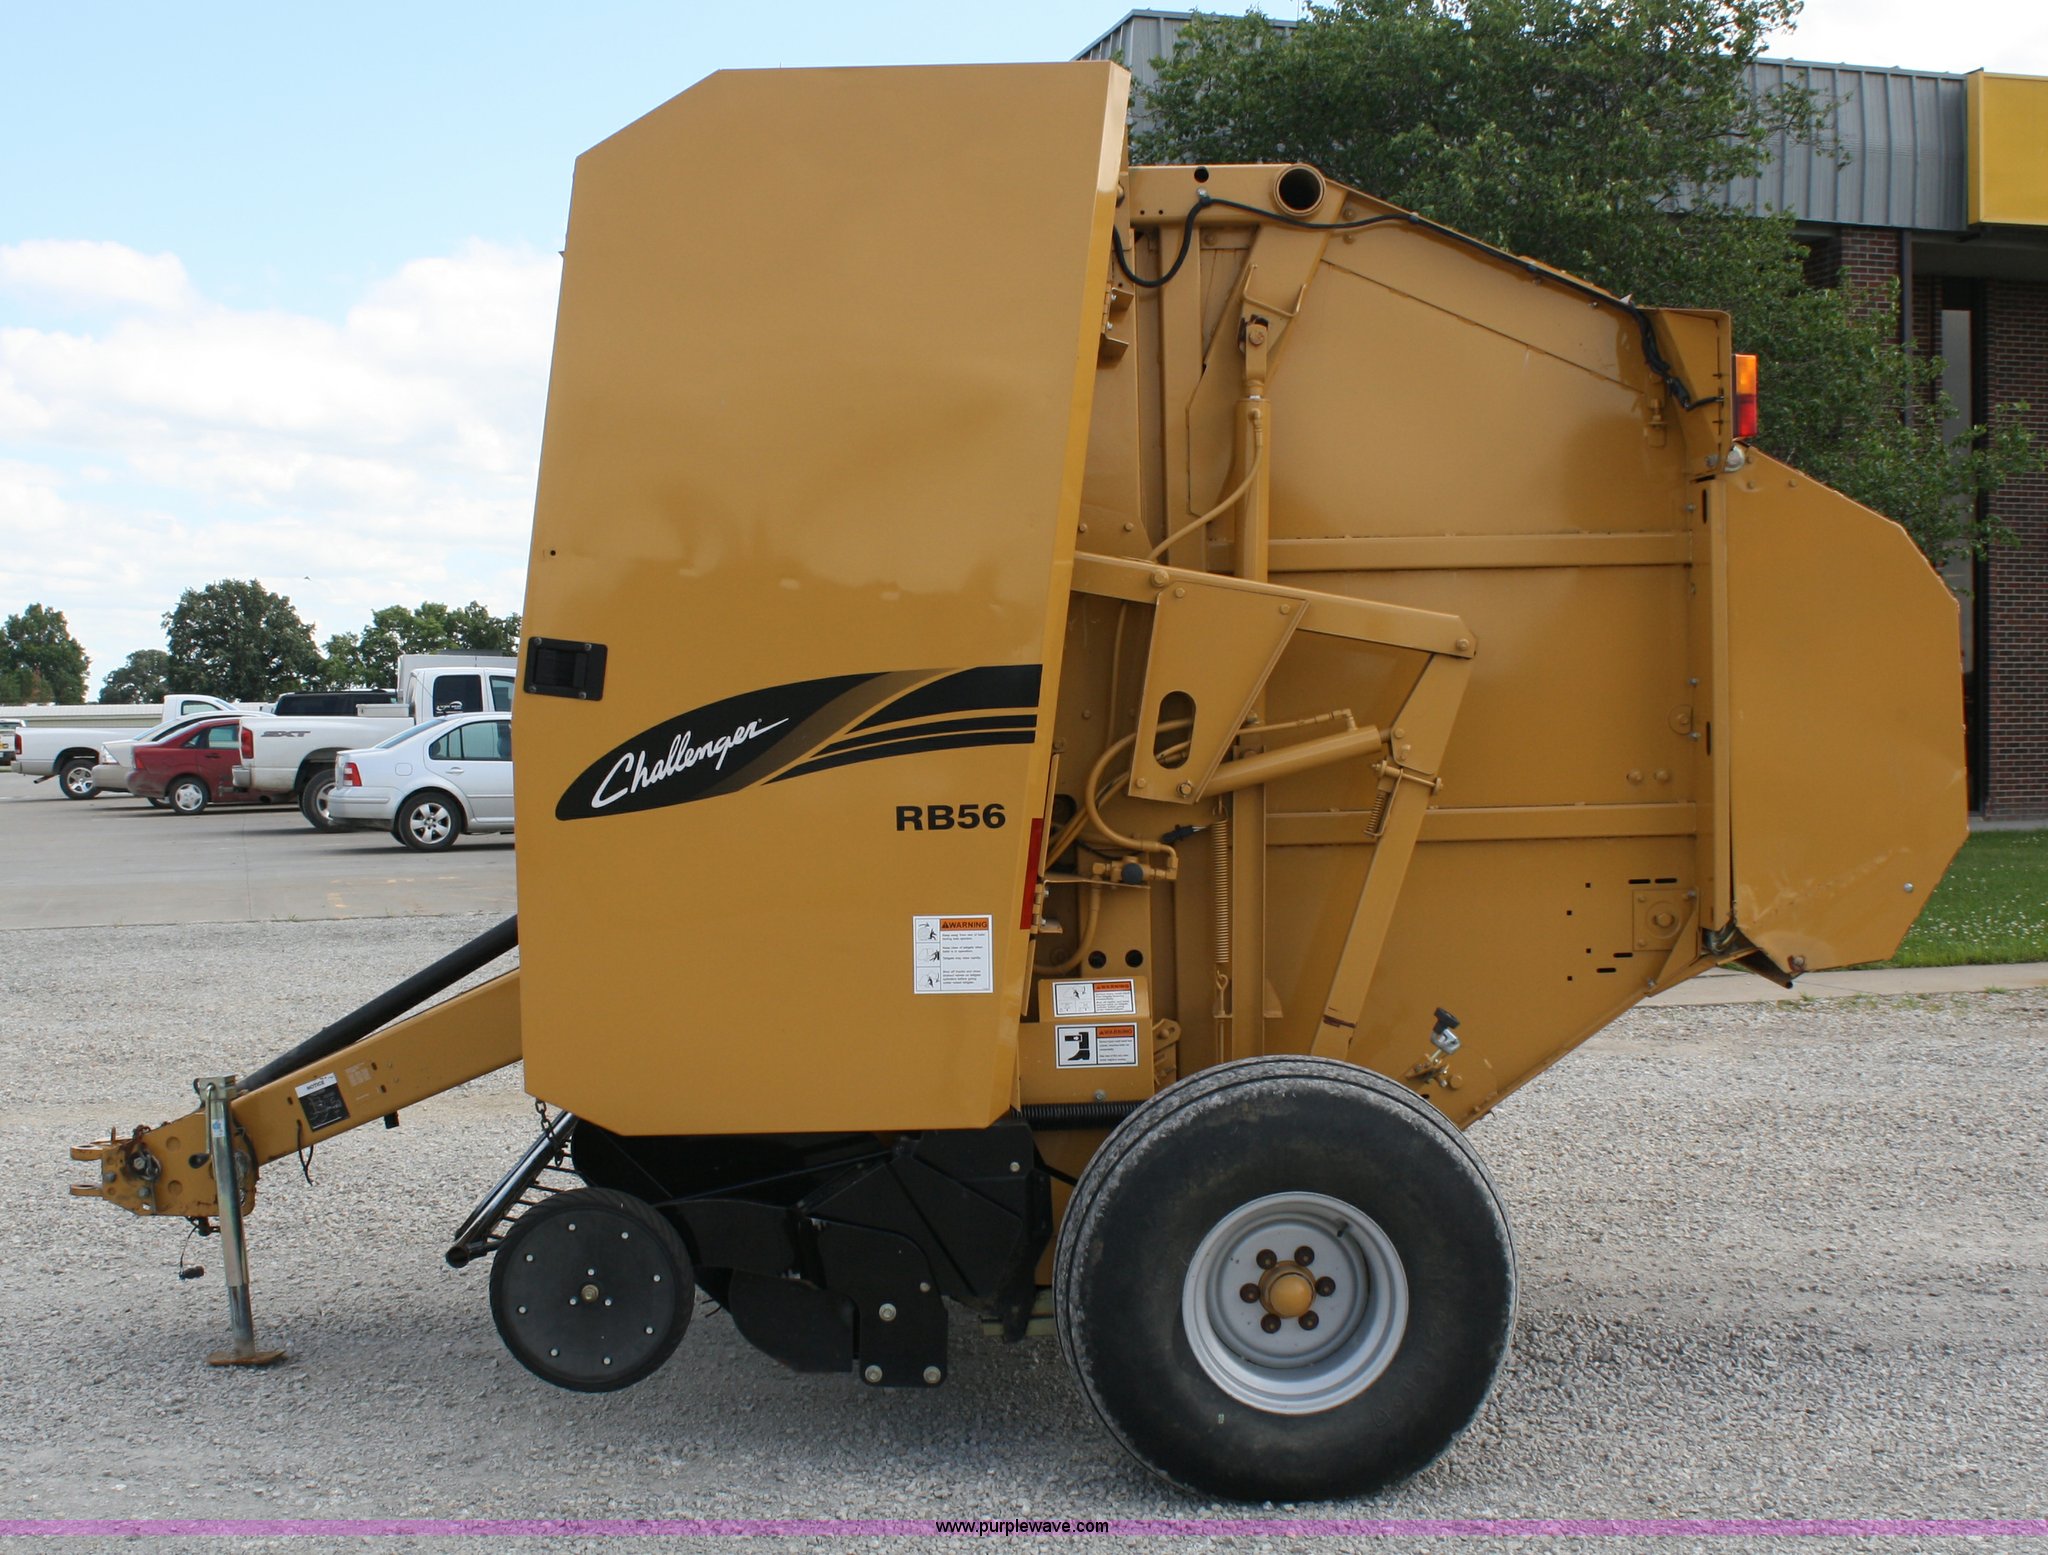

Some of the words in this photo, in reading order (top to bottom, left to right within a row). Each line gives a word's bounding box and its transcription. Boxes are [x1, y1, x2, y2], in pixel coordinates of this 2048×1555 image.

[591, 717, 789, 808] Challenger
[895, 803, 1006, 831] RB56
[949, 921, 988, 929] WARNING
